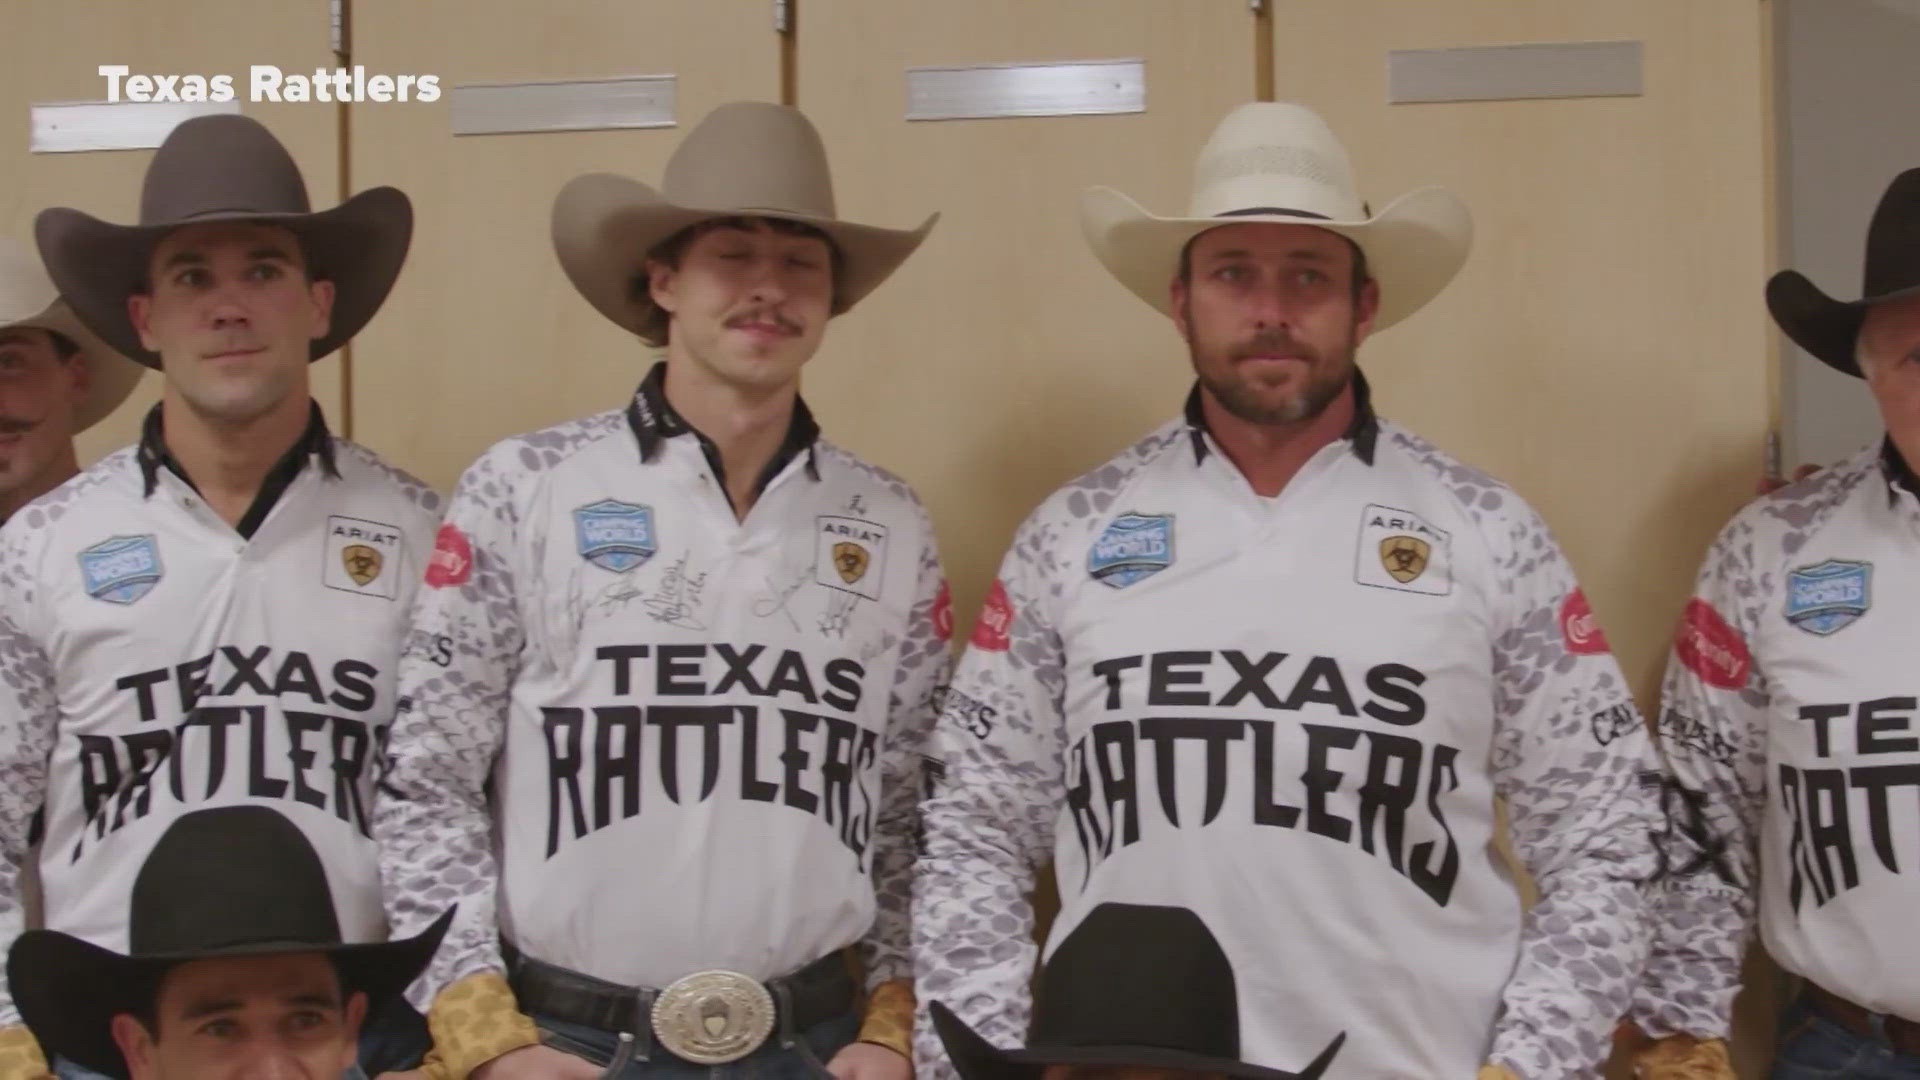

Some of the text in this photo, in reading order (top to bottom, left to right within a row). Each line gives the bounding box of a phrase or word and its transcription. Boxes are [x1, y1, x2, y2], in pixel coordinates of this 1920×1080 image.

[331, 525, 399, 546] ARIAT
[823, 522, 883, 545] ARIAT
[116, 644, 380, 723] TEXAS
[596, 642, 866, 713] TEXAS
[1092, 649, 1428, 727] TEXAS
[1798, 695, 1920, 759] TE
[539, 704, 879, 874] RATTLERS
[1066, 717, 1461, 908] RATTLERS
